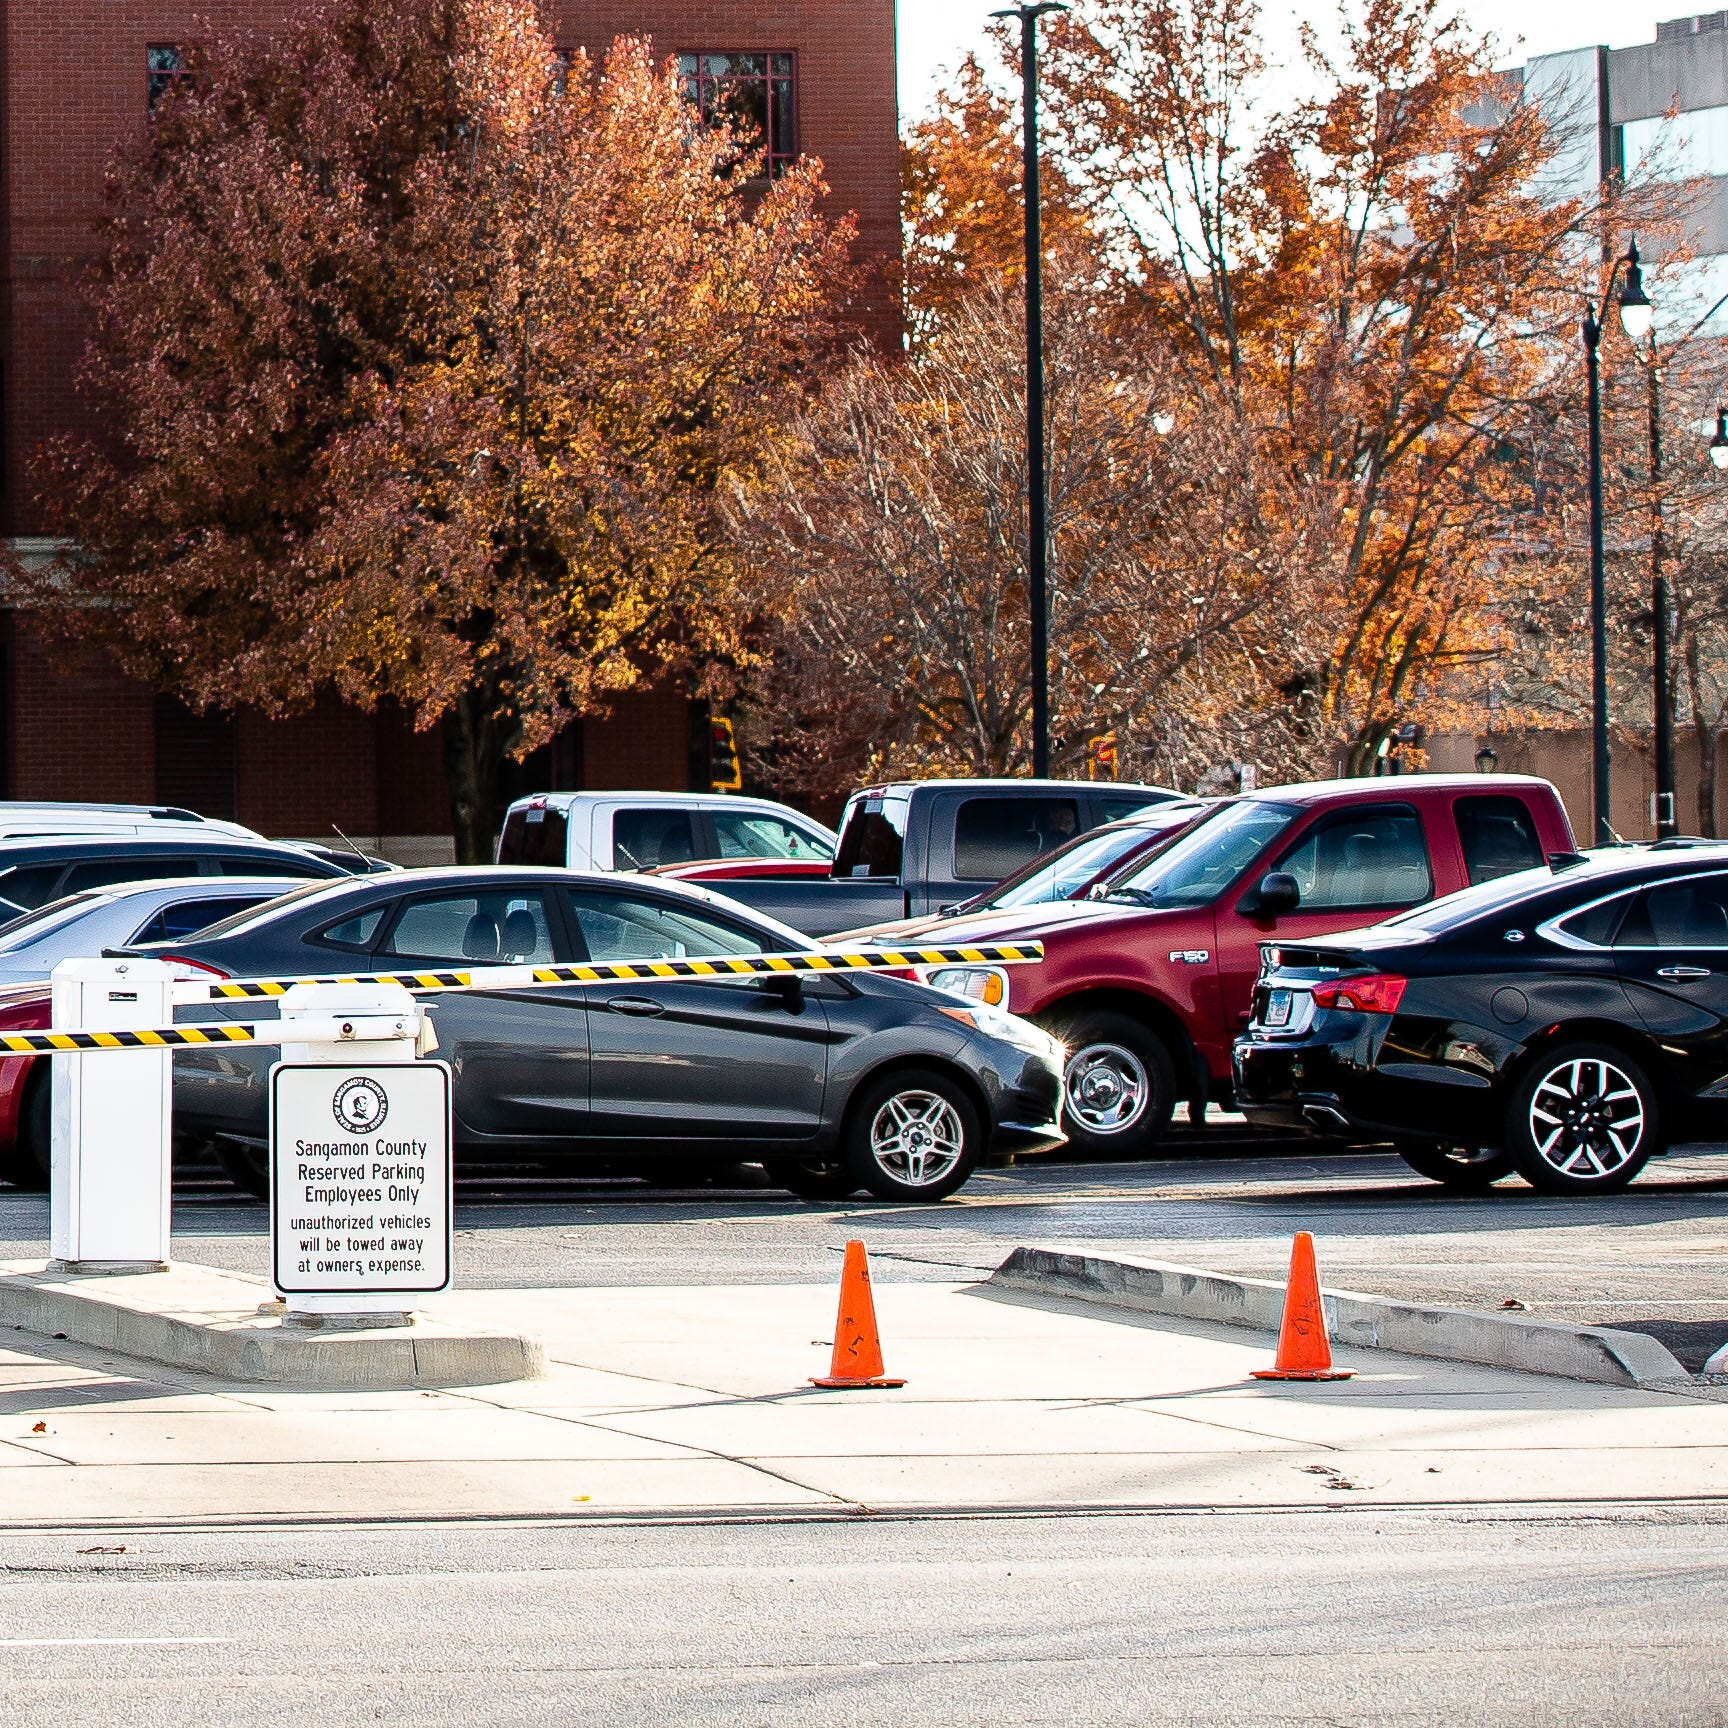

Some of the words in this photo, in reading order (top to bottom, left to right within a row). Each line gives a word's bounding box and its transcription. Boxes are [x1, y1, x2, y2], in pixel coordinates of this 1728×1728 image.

[295, 1139, 369, 1161] Sangamon
[375, 1138, 427, 1159] County
[298, 1163, 365, 1180] Reserved
[372, 1163, 425, 1184] Parking
[305, 1186, 382, 1206] Employees
[388, 1184, 419, 1205] Only
[290, 1214, 373, 1229] unauthorized
[379, 1214, 431, 1229] vehicles
[299, 1237, 320, 1251] will
[326, 1237, 341, 1251] be
[347, 1237, 385, 1251] towed
[390, 1239, 424, 1254] away
[298, 1258, 311, 1272] at
[368, 1259, 426, 1275] expense.
